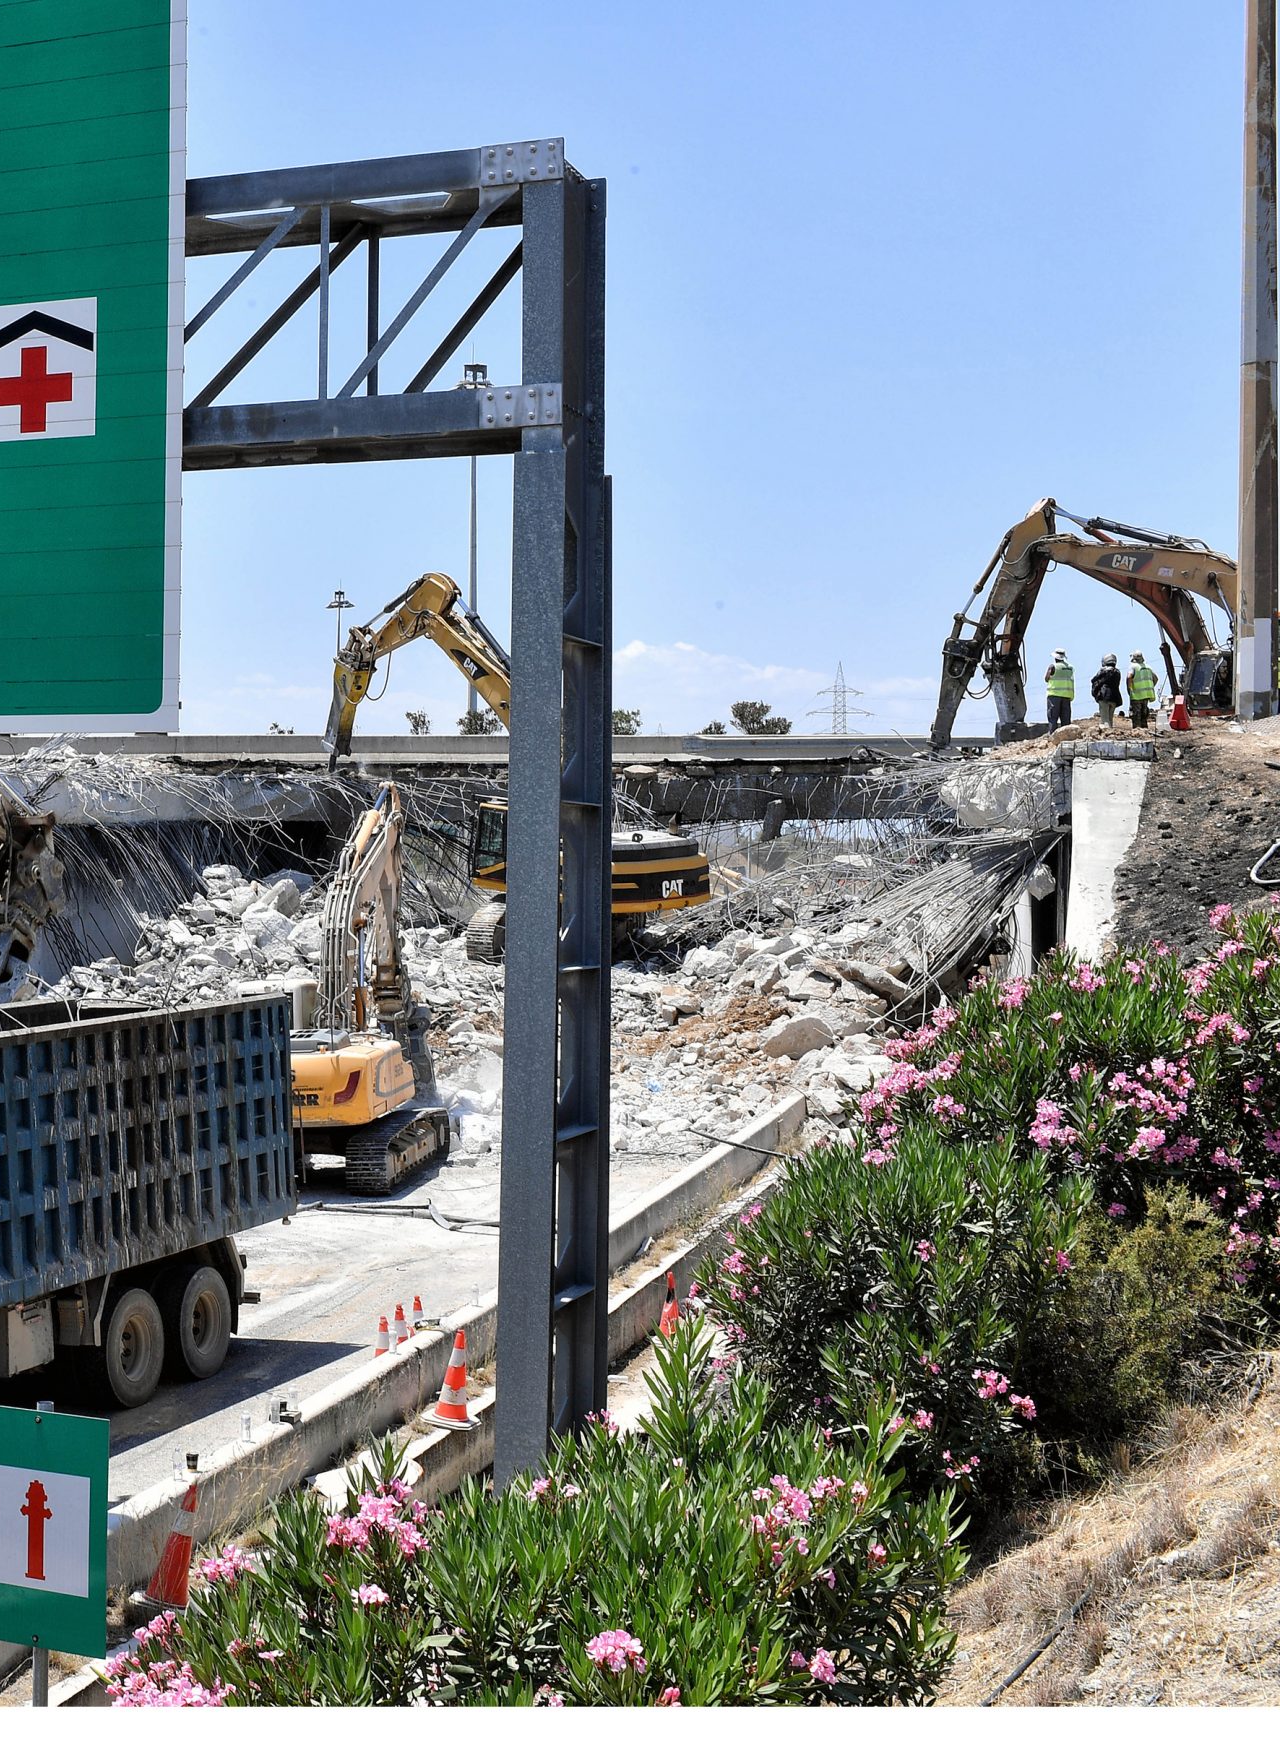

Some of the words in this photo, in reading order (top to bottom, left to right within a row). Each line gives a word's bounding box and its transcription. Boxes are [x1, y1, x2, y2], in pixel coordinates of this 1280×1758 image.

[1111, 554, 1137, 572] CAT
[463, 656, 478, 677] CAT
[661, 879, 684, 899] CAT
